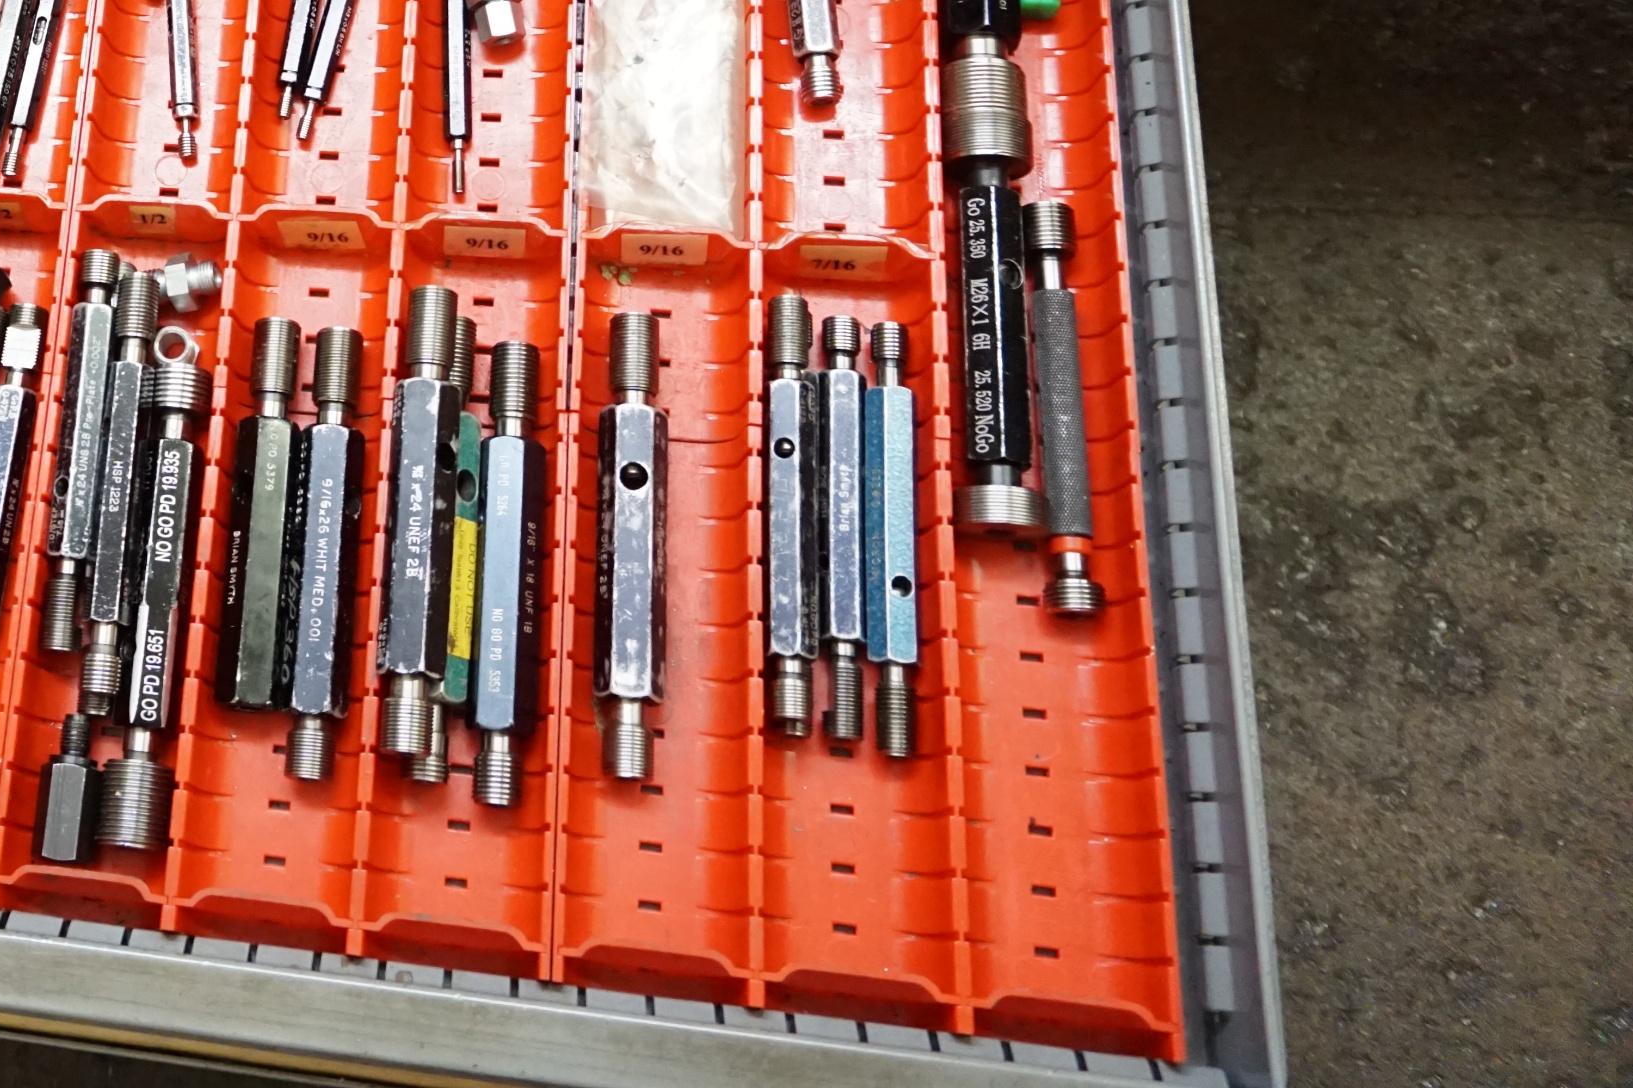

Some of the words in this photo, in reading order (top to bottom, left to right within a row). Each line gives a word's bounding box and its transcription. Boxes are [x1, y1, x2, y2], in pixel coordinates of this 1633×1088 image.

[967, 197, 985, 216] Go
[140, 213, 168, 224] 1/2
[307, 232, 349, 243] 9/16
[465, 238, 509, 250] 9/16
[967, 219, 986, 259] 25.350
[639, 244, 684, 256] 9/16
[812, 259, 856, 270] 7/16
[971, 333, 988, 351] 6H
[973, 371, 991, 412] 25.520
[974, 415, 995, 454] NoGo
[111, 460, 123, 483] HSP
[161, 449, 181, 491] 19.935
[108, 486, 120, 512] 1223
[159, 493, 177, 514] PD
[316, 477, 333, 534] 9/16x26
[157, 515, 175, 538] GO
[406, 515, 421, 554] UNEF
[154, 542, 173, 562] NO
[230, 529, 241, 564] BRIAN
[314, 537, 328, 571] WHIT
[405, 557, 418, 577] 2B
[526, 557, 535, 565] X
[226, 566, 238, 605] SMYTH
[465, 568, 476, 596] NOT
[523, 590, 534, 614] UNF
[491, 607, 504, 622] NO
[490, 627, 503, 642] GO
[523, 620, 532, 633] 1B
[144, 628, 164, 671] 19.651
[488, 647, 502, 661] PD
[142, 674, 160, 696] PD
[139, 697, 158, 721] GO
